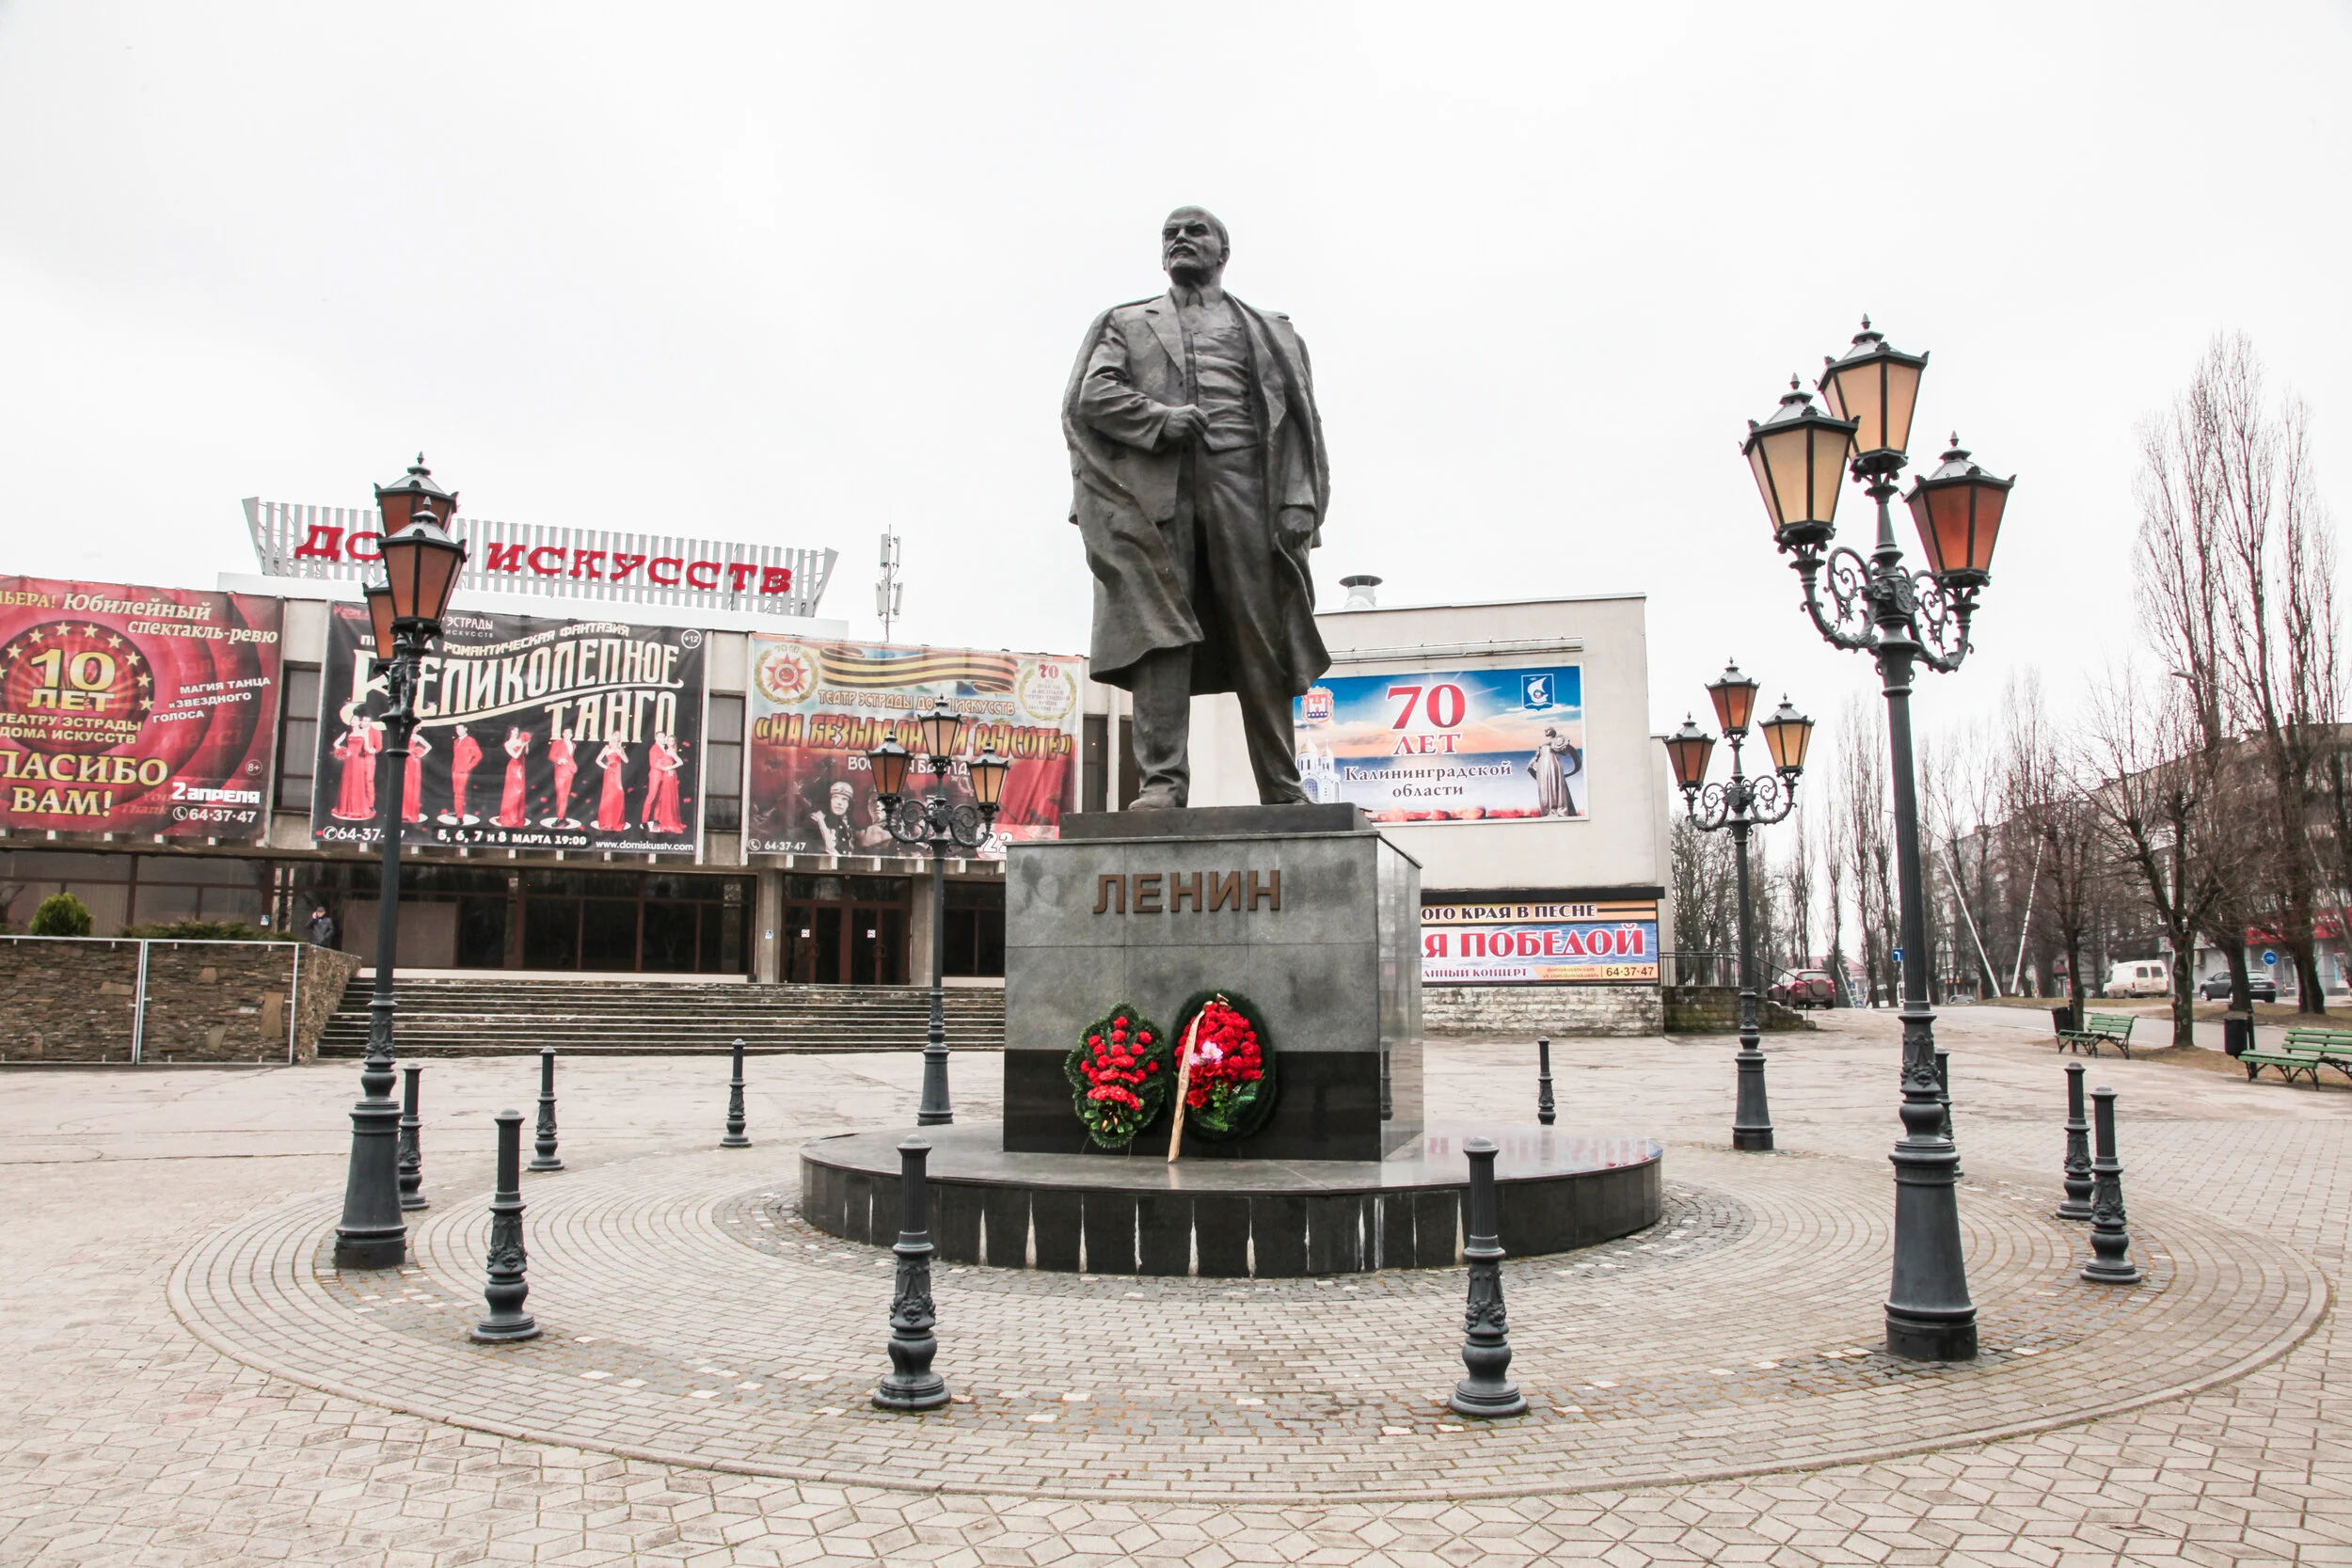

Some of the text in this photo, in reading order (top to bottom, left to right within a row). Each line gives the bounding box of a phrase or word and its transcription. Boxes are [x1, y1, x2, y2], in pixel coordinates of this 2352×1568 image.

[294, 524, 792, 595] ДО ИСКУССТВ
[62, 593, 212, 621] Юбилейный
[128, 620, 278, 644] спектакль-ревю
[447, 616, 494, 630] ЭСТРАДЫ
[443, 630, 555, 657] РОМАНТИЧЕСКАЯ
[559, 622, 630, 638] ФАНТАЗИЯ
[30, 648, 116, 690] 10
[1039, 664, 1058, 678] 70
[180, 676, 271, 694] МАГИЯ ТАНЦА
[27, 689, 116, 712] ЛЕТ
[176, 692, 252, 708] ЗВЕЗДНОГО
[818, 689, 855, 705] ТЕАТР
[859, 692, 914, 710] ЭСТРАДЫ
[953, 699, 1015, 717] ИСКУССТВ
[1386, 684, 1466, 730] 70
[0, 712, 142, 732] ТЕАТРУ ЭСТРАДЫ
[152, 710, 205, 723] ГОЛОСА
[545, 690, 677, 743] ТАНГО
[51, 730, 137, 745] ИСКУССТВ
[1392, 732, 1462, 755] ЛЕТ
[246, 763, 261, 772] 8+
[1344, 760, 1513, 785] Калининградской
[172, 782, 186, 800] 2
[1391, 782, 1464, 799] области
[10, 786, 113, 817] ВАМ!
[437, 829, 587, 846] 5, 6, 7 и 8 МАРТА 19:00
[596, 839, 694, 851] www.domiskusstv.com
[1092, 869, 1280, 914] ЛЕНИН
[1461, 906, 1512, 919] КРАЯ
[1517, 905, 1530, 918] В
[1534, 904, 1597, 917] ПЕСНЕ
[1460, 924, 1644, 958] ПОБЕДОЙ
[1472, 968, 1528, 977] КОНЦЕРТ
